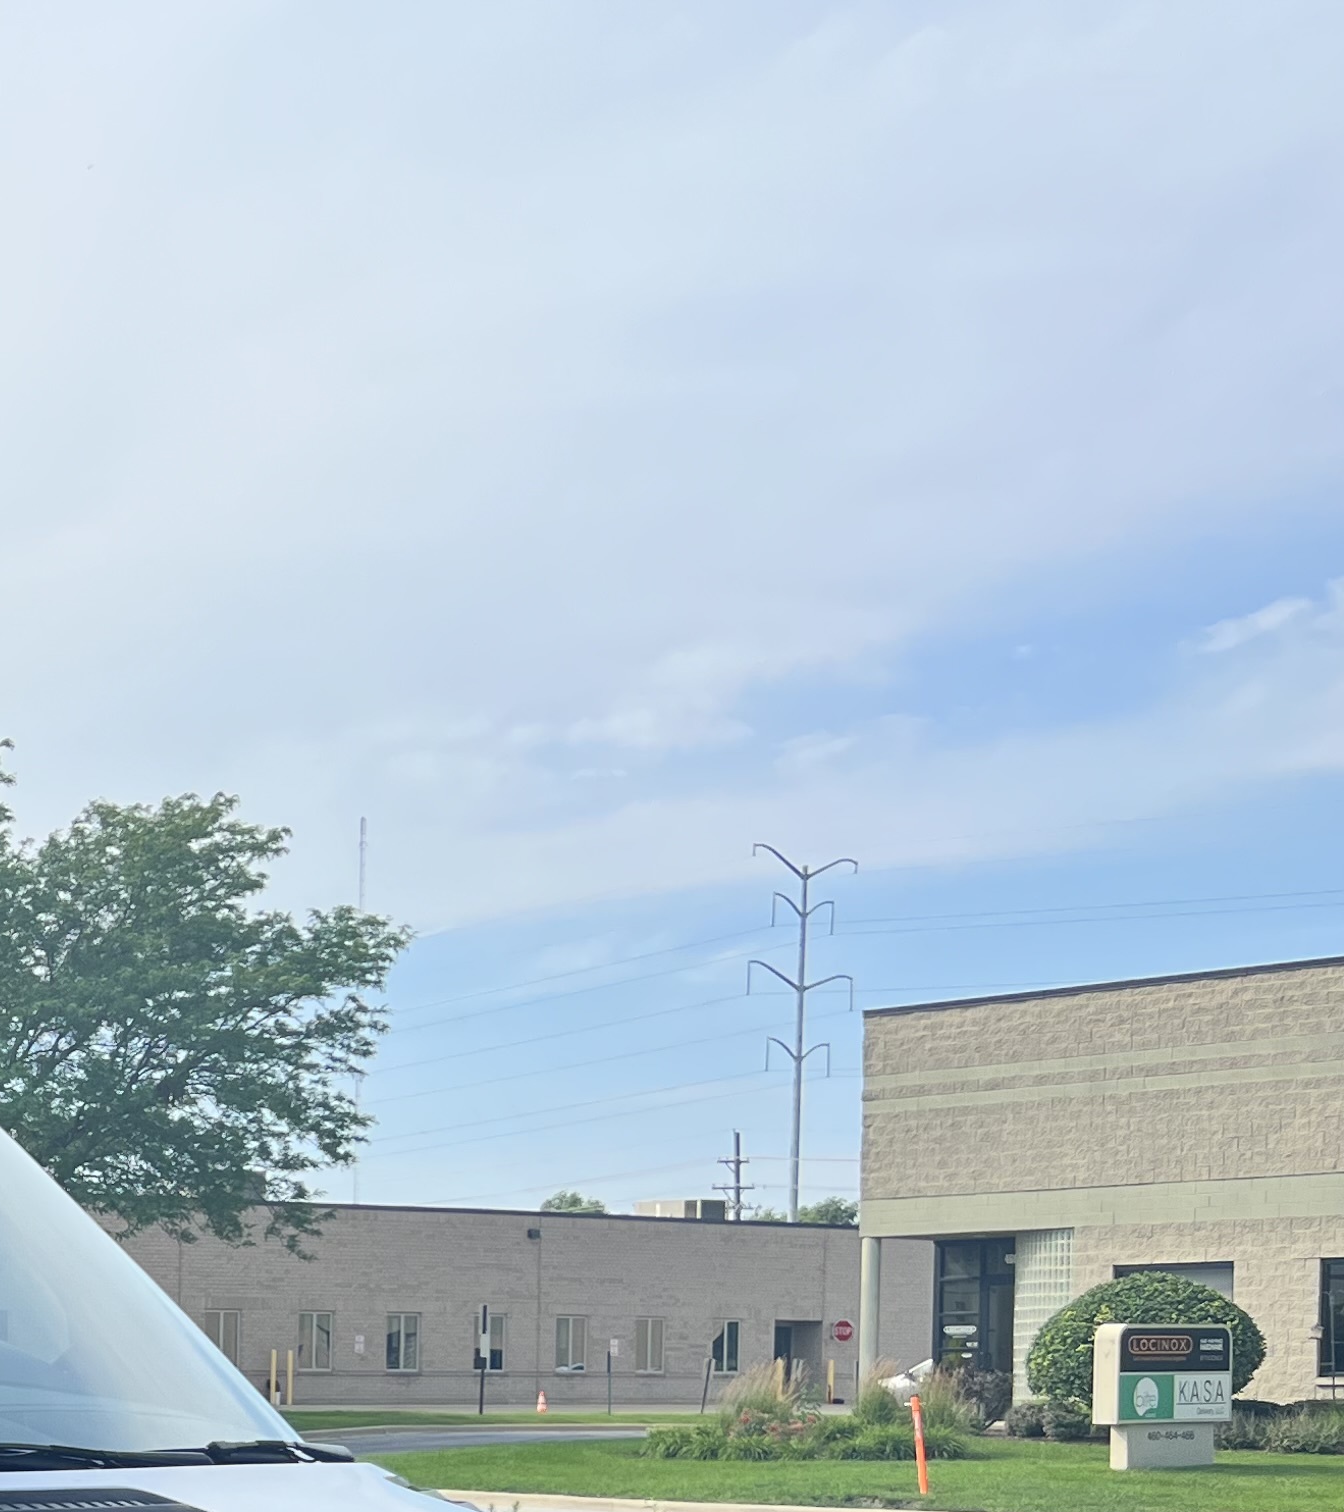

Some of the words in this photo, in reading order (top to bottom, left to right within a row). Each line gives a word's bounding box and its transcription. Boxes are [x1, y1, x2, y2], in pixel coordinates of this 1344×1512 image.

[835, 1326, 851, 1336] STOP
[1132, 1338, 1188, 1351] LOCINOX
[1179, 1380, 1224, 1402] KASA
